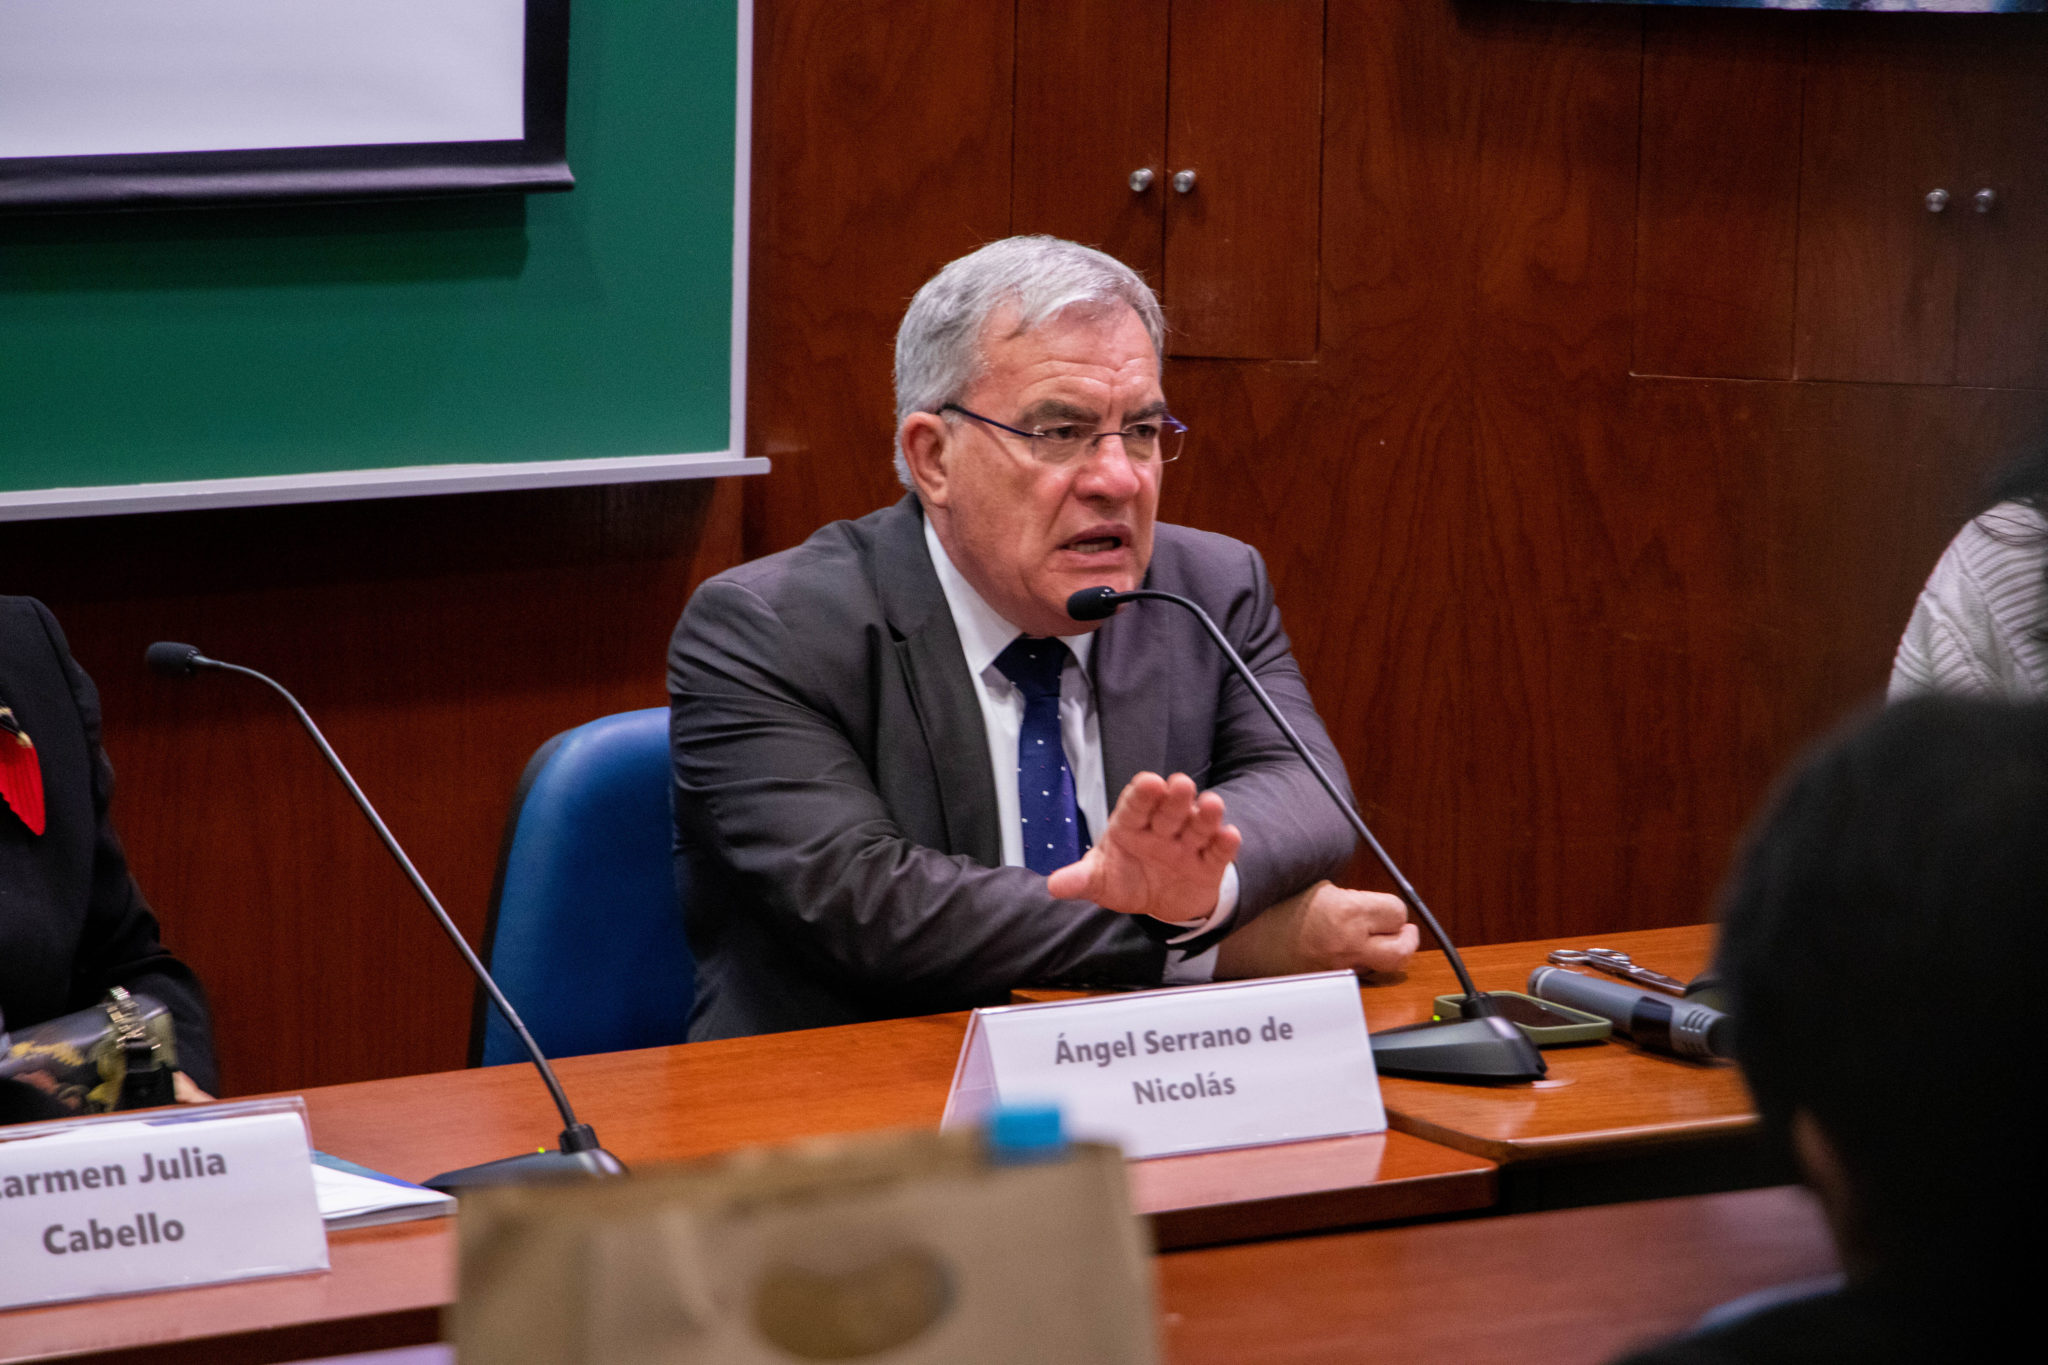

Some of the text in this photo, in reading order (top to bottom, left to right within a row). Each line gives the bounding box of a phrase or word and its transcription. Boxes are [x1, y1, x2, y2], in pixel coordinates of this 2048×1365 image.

[1055, 1016, 1294, 1067] Ángel Serrano de
[1132, 1072, 1236, 1105] Nicolás
[0, 1147, 227, 1199] armen Julia
[42, 1212, 185, 1255] Cabello
